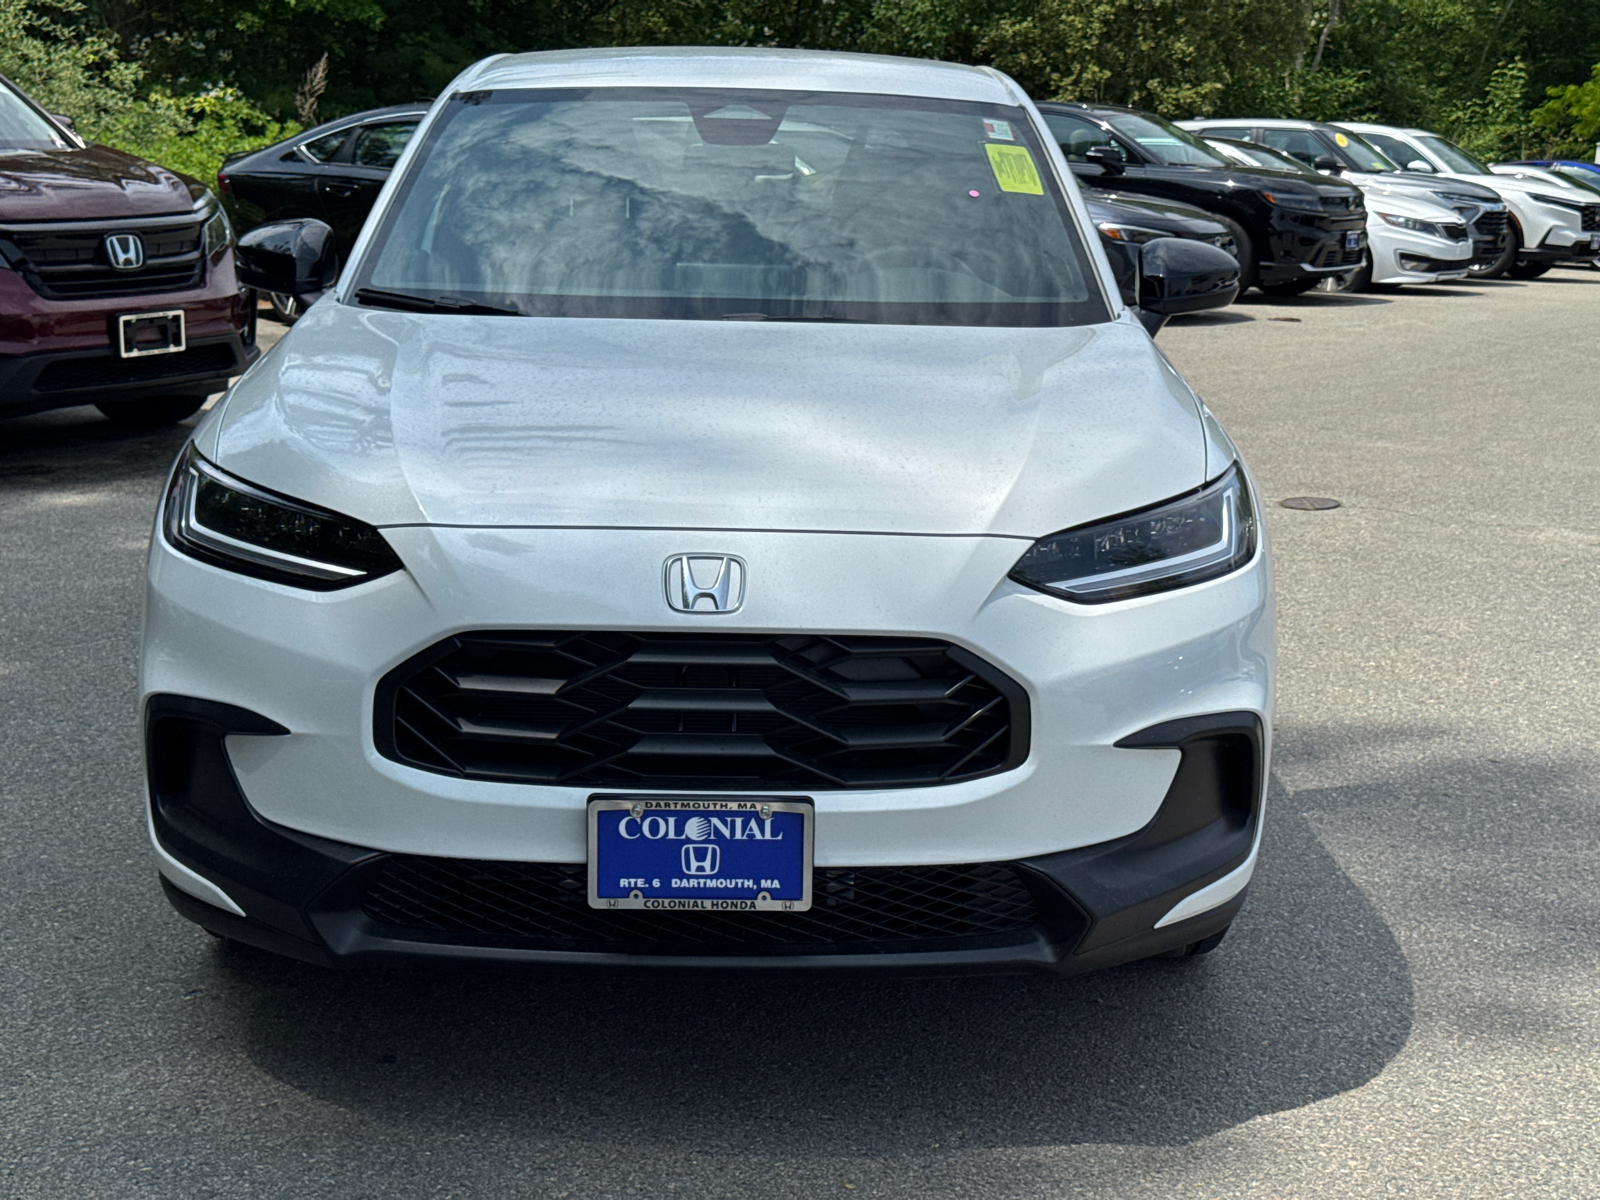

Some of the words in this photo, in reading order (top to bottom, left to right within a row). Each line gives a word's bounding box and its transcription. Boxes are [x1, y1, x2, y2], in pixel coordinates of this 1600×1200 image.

[645, 801, 733, 811] DARTMOUTH,
[737, 802, 758, 811] MA
[618, 816, 783, 841] COLONIAL
[619, 878, 649, 888] RTE.
[652, 878, 661, 888] 6
[671, 878, 757, 890] DARTMOUTH,
[760, 879, 781, 889] MA
[643, 899, 708, 910] COLONIAL
[711, 900, 757, 910] HONDA
